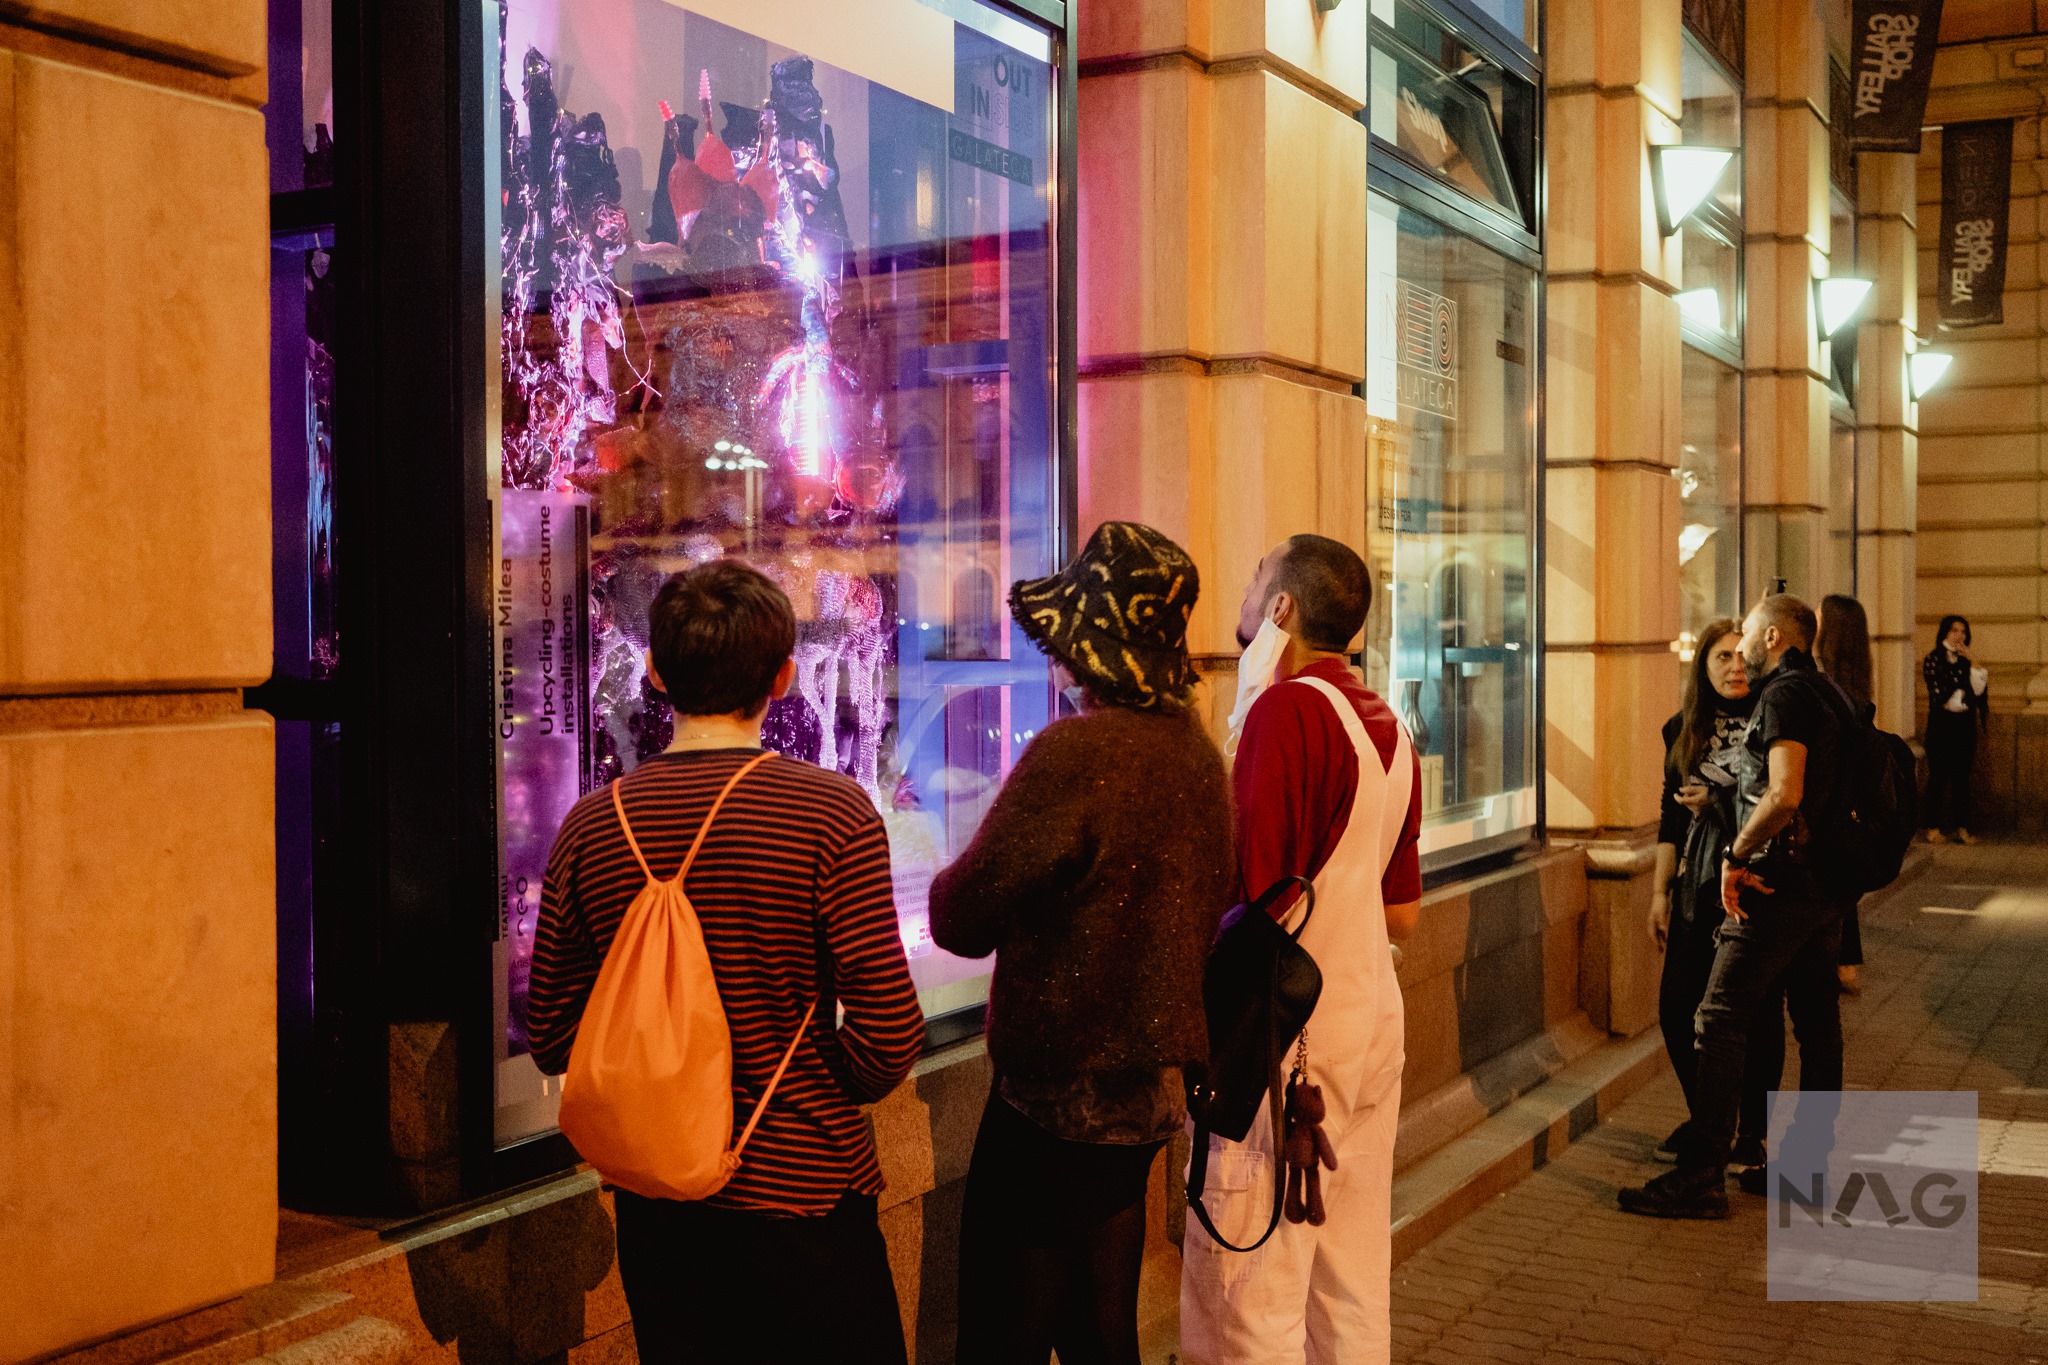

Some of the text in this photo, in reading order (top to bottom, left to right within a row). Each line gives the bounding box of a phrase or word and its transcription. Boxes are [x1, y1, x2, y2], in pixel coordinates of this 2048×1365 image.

[993, 54, 1032, 97] OUT
[953, 135, 1031, 181] GALATECA
[1383, 366, 1454, 411] GALATECA
[499, 559, 514, 739] Cristina Milea
[539, 506, 555, 735] Upcycling-costume
[561, 594, 574, 734] installations
